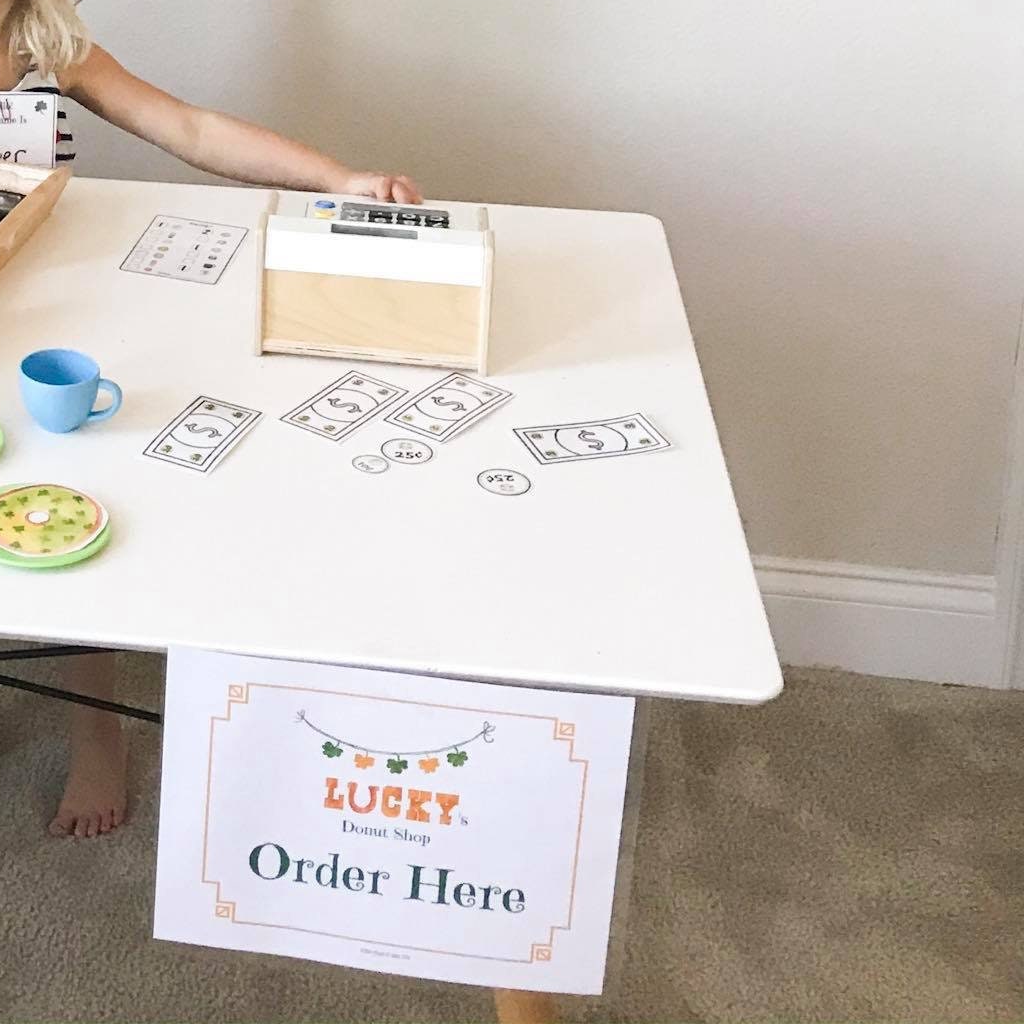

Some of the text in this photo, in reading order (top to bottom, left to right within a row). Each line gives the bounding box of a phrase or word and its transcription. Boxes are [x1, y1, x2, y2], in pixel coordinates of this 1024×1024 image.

[342, 820, 431, 847] Donut Shop
[248, 842, 527, 914] Order Here
